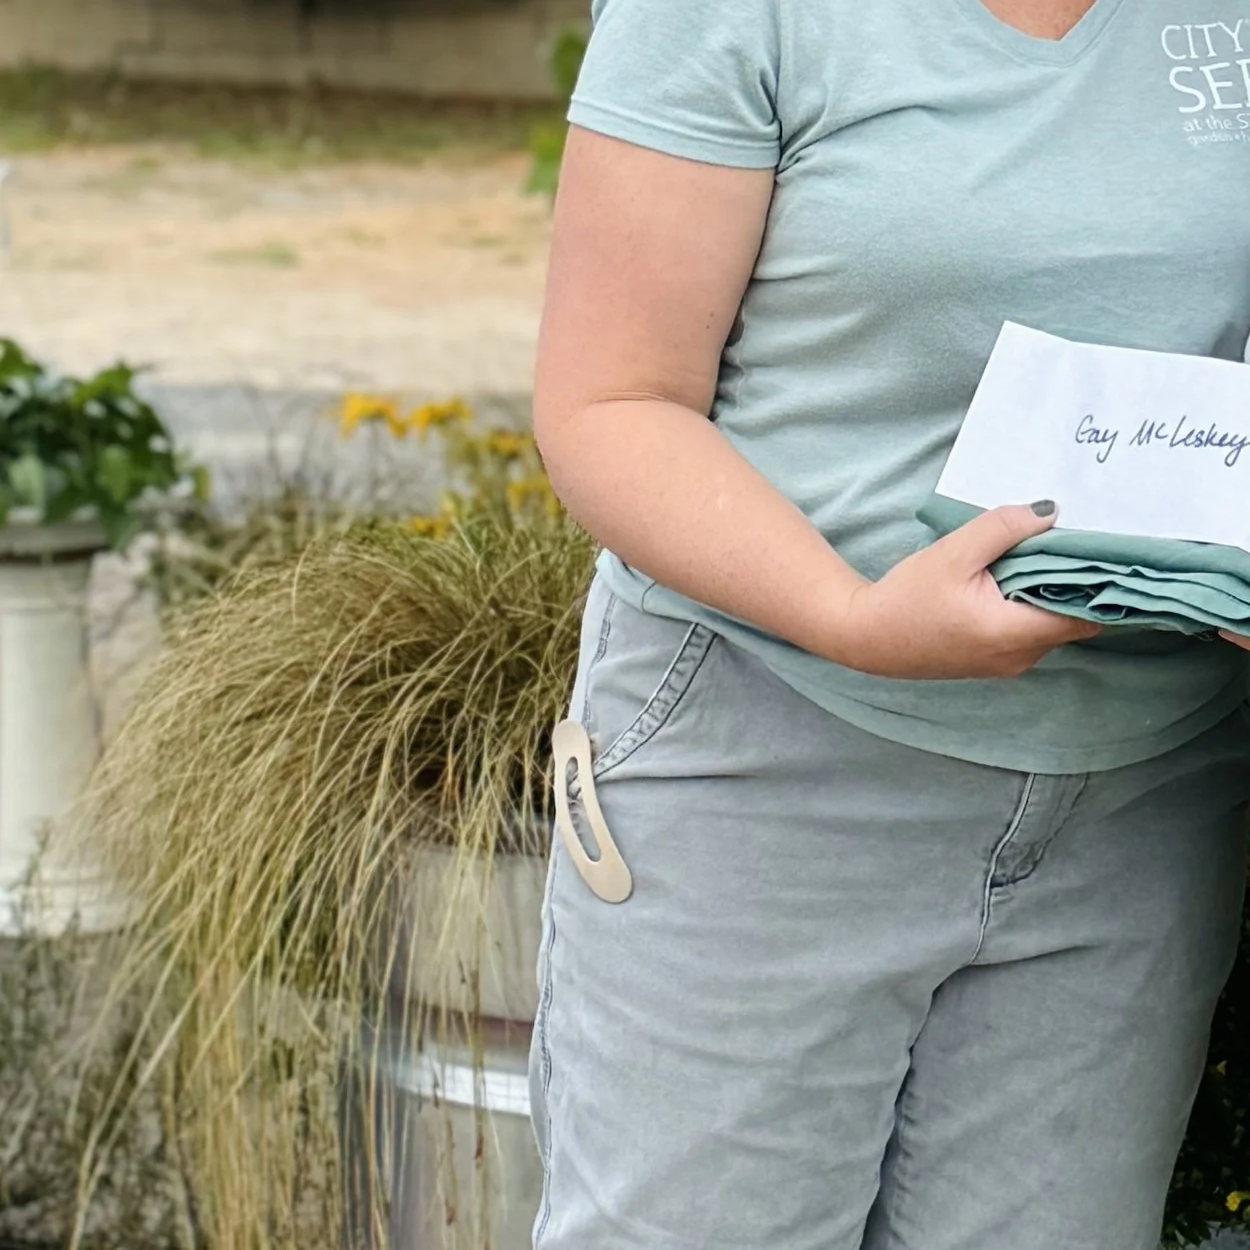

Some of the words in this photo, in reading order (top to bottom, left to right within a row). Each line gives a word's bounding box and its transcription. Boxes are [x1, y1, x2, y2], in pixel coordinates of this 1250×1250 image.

[1161, 19, 1250, 60] CITY
[1184, 118, 1203, 132] at
[1206, 114, 1234, 130] the
[1075, 414, 1119, 464] Gay
